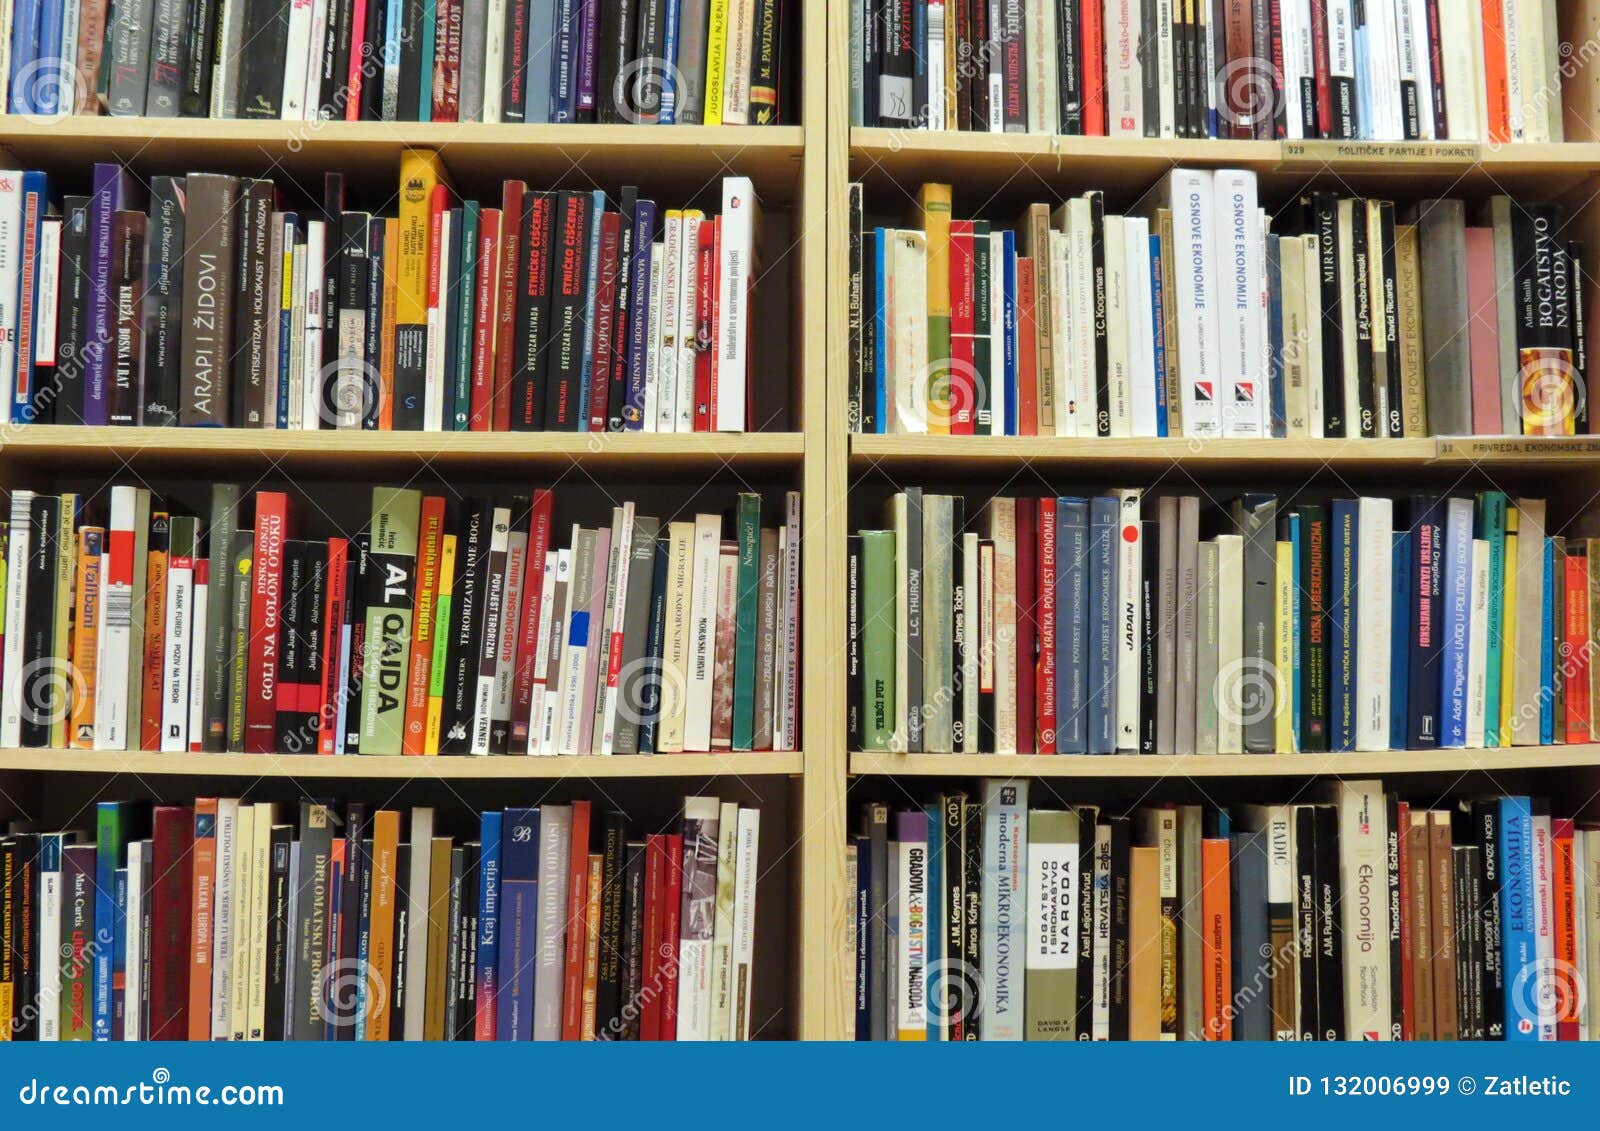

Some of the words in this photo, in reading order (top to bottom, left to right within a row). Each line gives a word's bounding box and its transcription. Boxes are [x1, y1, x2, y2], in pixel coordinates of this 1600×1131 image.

[448, 5, 461, 62] BABILON
[710, 44, 721, 116] JUGOSLAVIJA
[1341, 82, 1349, 114] CHOMSKY
[1338, 145, 1385, 156] POLITIČKE
[1388, 147, 1427, 157] PARTIJE
[1435, 148, 1474, 157] POKRETI
[255, 199, 266, 255] ANTIFAŠIZAM
[528, 198, 543, 247] ČIŠĆENJE
[562, 197, 577, 246] ČIŠĆENJE
[1189, 193, 1203, 240] OSNOVE
[1233, 194, 1245, 241] OSNOVE
[503, 234, 518, 279] Hrvatskoj
[1318, 210, 1335, 283] MIRKOVIĆ
[253, 259, 264, 314] HOLOKAUST
[527, 250, 541, 296] ETNIČKO
[561, 249, 575, 295] ETNIČKO
[1191, 243, 1205, 309] EKONOMIJE
[1234, 244, 1248, 309] EKONOMIJE
[1522, 278, 1532, 302] Smith
[1534, 216, 1553, 327] BOGATSTVO
[1553, 248, 1569, 327] NARODA
[193, 253, 217, 331] ŽIDOVI
[502, 290, 514, 323] Slovaci
[1384, 278, 1395, 314] Ricardo
[158, 306, 166, 330] COLIN
[529, 306, 539, 333] LIVADA
[562, 306, 573, 331] LIVADA
[1385, 315, 1395, 341] David
[1523, 305, 1533, 328] Adam
[157, 332, 166, 367] CHAPMAN
[251, 319, 262, 386] ANTISEMITIZAM
[527, 334, 538, 371] SVETOZAR
[561, 333, 572, 370] SVETOZAR
[195, 349, 213, 415] ARAPI
[259, 515, 269, 554] JONJIĆ
[267, 514, 281, 567] OTOKU
[469, 512, 480, 543] BOGA
[743, 522, 754, 567] Nemoguće!
[1044, 512, 1054, 565] EKONOMIJE
[1420, 524, 1431, 564] SVJETSKI
[1432, 525, 1440, 548] Adolf
[425, 530, 438, 566] svjetski
[466, 546, 477, 567] IME
[1073, 531, 1083, 569] ANALIZE
[257, 557, 267, 594] DINKO
[290, 559, 300, 591] nevjeste
[312, 560, 322, 592] nevjeste
[384, 563, 406, 603] AL
[425, 568, 434, 586] novi
[508, 548, 522, 587] MINUTE
[1420, 567, 1431, 596] IZAZOV
[1432, 551, 1441, 596] Dragičević
[83, 561, 100, 628] Talibani
[174, 584, 184, 611] FRANK
[264, 573, 278, 628] GOLOM
[288, 592, 298, 623] Alahove
[490, 573, 502, 611] POVIJEST
[954, 586, 964, 611] Tobin
[1044, 568, 1054, 609] POVIJEST
[1073, 572, 1082, 623] EKONOMSKE
[174, 612, 183, 638] FUREDI
[311, 594, 320, 624] Alahove
[417, 590, 432, 641] TERORIZAM
[459, 580, 474, 645] TERORIZAM
[502, 591, 517, 662] SUDBONOSNE
[1126, 602, 1135, 652] JAPAN
[1419, 599, 1431, 647] HRVATSKOJ
[288, 628, 297, 649] Juzik
[310, 630, 319, 650] Juzik
[485, 613, 498, 659] TERORIZMA
[696, 618, 707, 653] MORAVSKI
[954, 613, 964, 646] James
[1044, 612, 1054, 648] KRATKA
[1072, 628, 1081, 664] POVIJEST
[172, 644, 182, 664] POZIV
[286, 650, 295, 669] Julia
[308, 651, 317, 670] Julia
[377, 613, 404, 714] QAIDA
[457, 657, 466, 681] STERN
[695, 655, 705, 680] HRVATI
[1045, 652, 1055, 674] Piper
[171, 679, 180, 704] TEROR
[261, 662, 274, 700] GOLI
[454, 681, 464, 711] JESSICA
[480, 683, 489, 715] DOMINIQUE
[1044, 678, 1054, 716] Nikolaus
[477, 717, 488, 748] VENNER
[998, 812, 1008, 871] moderna
[1389, 831, 1398, 870] Schultz
[1535, 829, 1546, 881] pokazatelji
[75, 873, 85, 892] Mark
[482, 860, 497, 913] imperija
[1301, 875, 1312, 909] Eatwell
[1416, 860, 1424, 892] velikana
[1440, 859, 1448, 891] velikana
[1506, 816, 1524, 932] EKONOMIJA
[74, 899, 84, 926] Curtis
[312, 854, 326, 945] DIPLOMATSKI
[1040, 860, 1049, 955] BOGATSTVO
[1049, 861, 1057, 945] SIROMAŠTVO
[1060, 861, 1070, 954] NARODA
[1356, 864, 1374, 952] Ekonomija
[1390, 890, 1400, 941] Theodore
[1417, 893, 1427, 927] povratak
[1441, 893, 1450, 927] povratak
[1538, 884, 1549, 937] Ekonomski
[481, 916, 496, 945] Kraj
[995, 876, 1012, 1014] MIKROEKONOMIKA
[1302, 913, 1313, 958] Robinson
[1417, 929, 1427, 959] Keynes:
[1441, 929, 1450, 959] Keynes:
[309, 951, 322, 1024] PROTOKOL
[484, 966, 493, 989] Todd
[1359, 966, 1367, 1007] Nordhaus
[1369, 965, 1378, 1012] Samuelson
[484, 989, 493, 1036] Emmanuel
